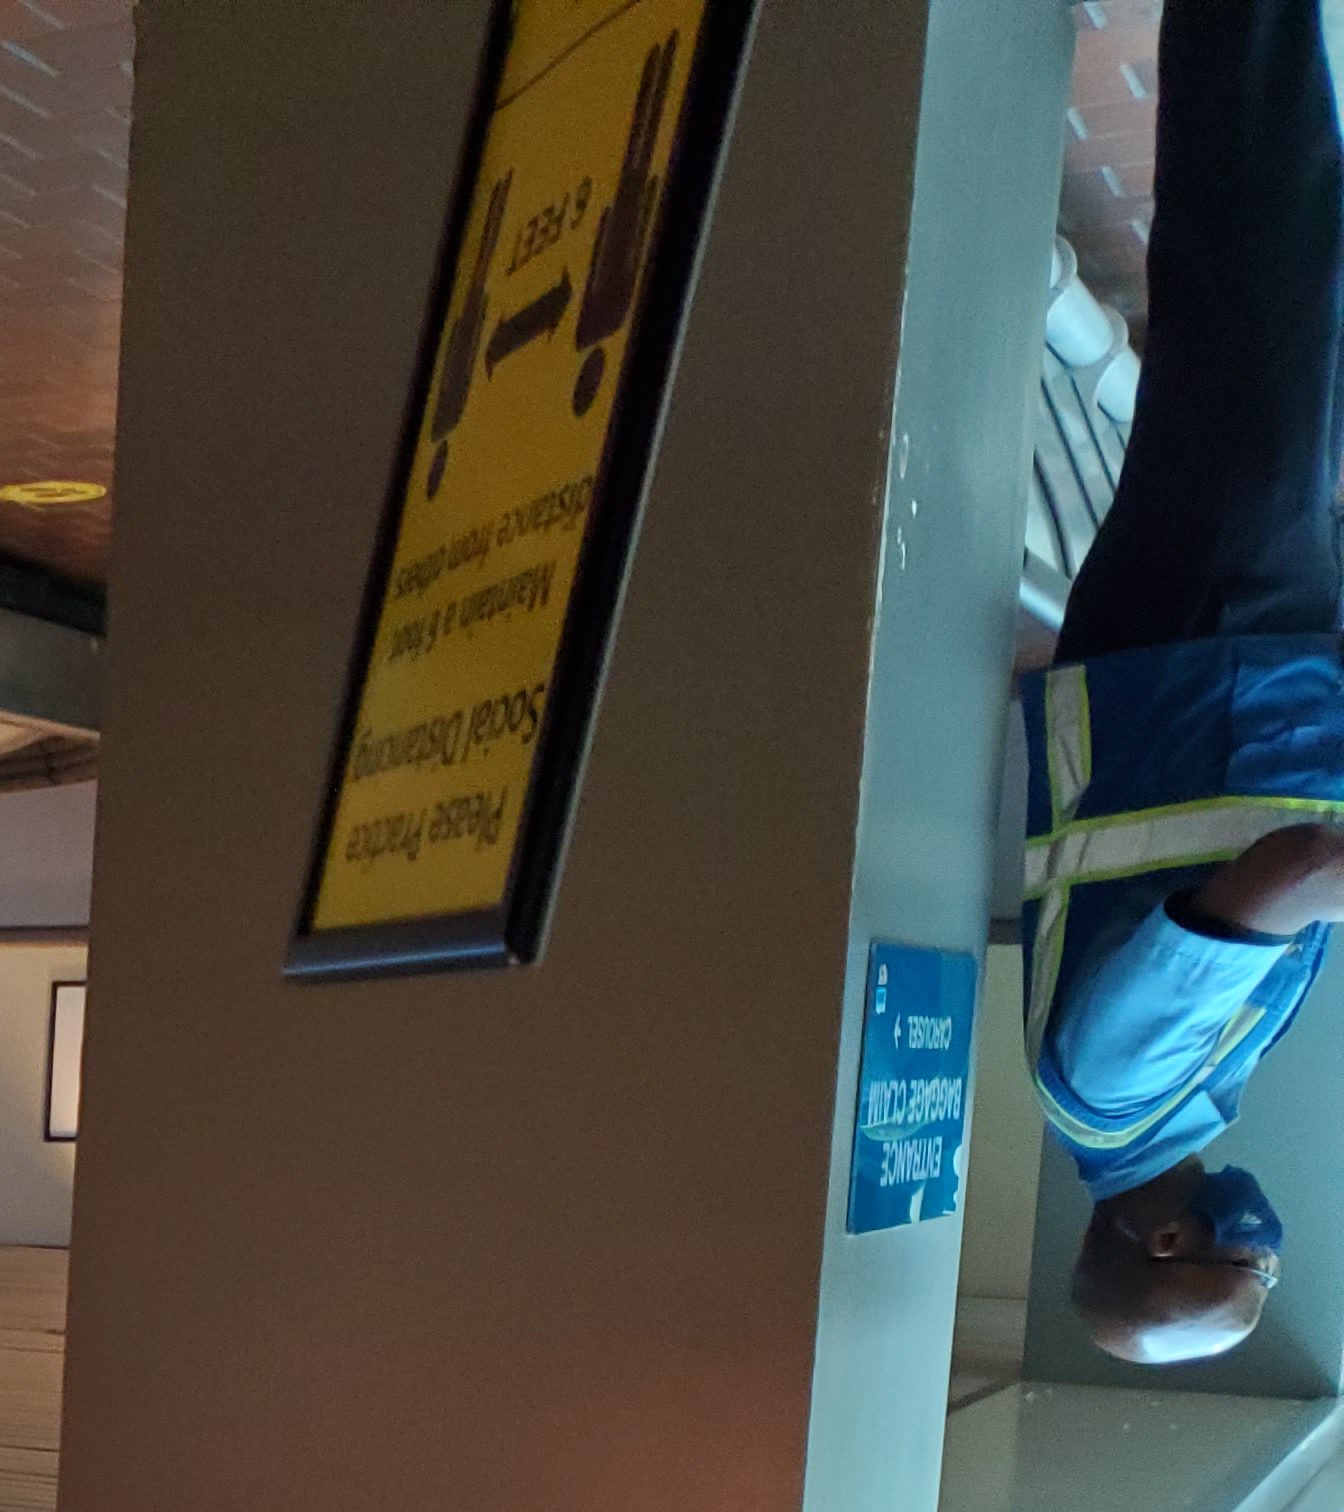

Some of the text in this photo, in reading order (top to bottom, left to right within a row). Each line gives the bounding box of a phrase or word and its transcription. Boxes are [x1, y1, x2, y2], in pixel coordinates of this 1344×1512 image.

[505, 175, 592, 277] 6 FEET
[395, 476, 594, 602] distance from others
[387, 560, 557, 666] Maintain a 6 foot
[349, 682, 544, 784] Social Distancing
[345, 787, 509, 864] Please Practice
[906, 1015, 952, 1051] CAROUSEL
[866, 1077, 962, 1127] BAGGAGE CLAIM
[879, 1136, 943, 1187] ENTRANCE
